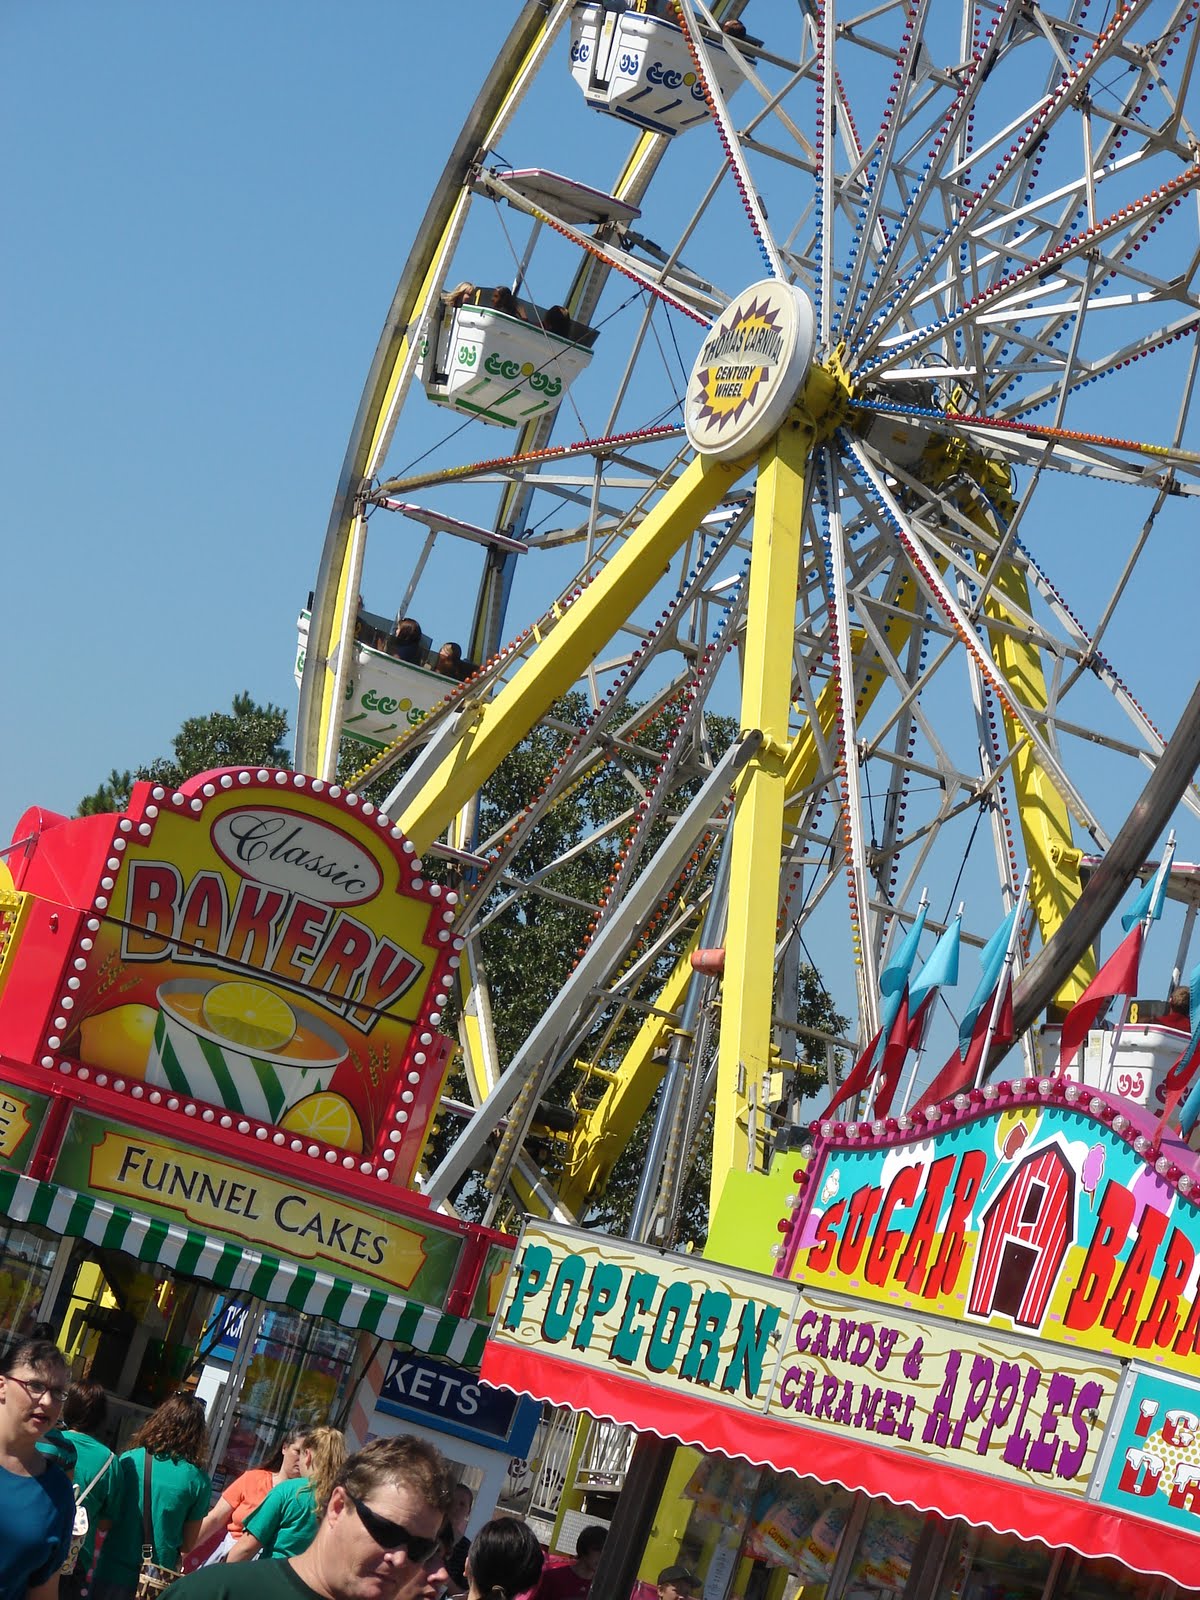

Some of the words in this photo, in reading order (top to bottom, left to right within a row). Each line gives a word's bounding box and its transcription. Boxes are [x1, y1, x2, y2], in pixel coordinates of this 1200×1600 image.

[700, 327, 746, 366] THOMAS
[744, 326, 784, 365] CARNIVAL
[715, 365, 756, 380] CENTURY
[714, 382, 743, 398] WHEEL
[228, 814, 367, 895] Classic
[120, 860, 424, 1035] BAKERY
[1130, 1003, 1138, 1024] 8
[117, 1147, 260, 1221] FUNNEL
[274, 1195, 388, 1266] CAKES
[807, 1149, 987, 1299] SUGAR
[503, 1243, 782, 1399] POPCORN
[795, 1310, 899, 1371] CANDY
[902, 1337, 924, 1380] &
[780, 1365, 917, 1441] CARAMEL
[921, 1349, 1105, 1480] APPLES
